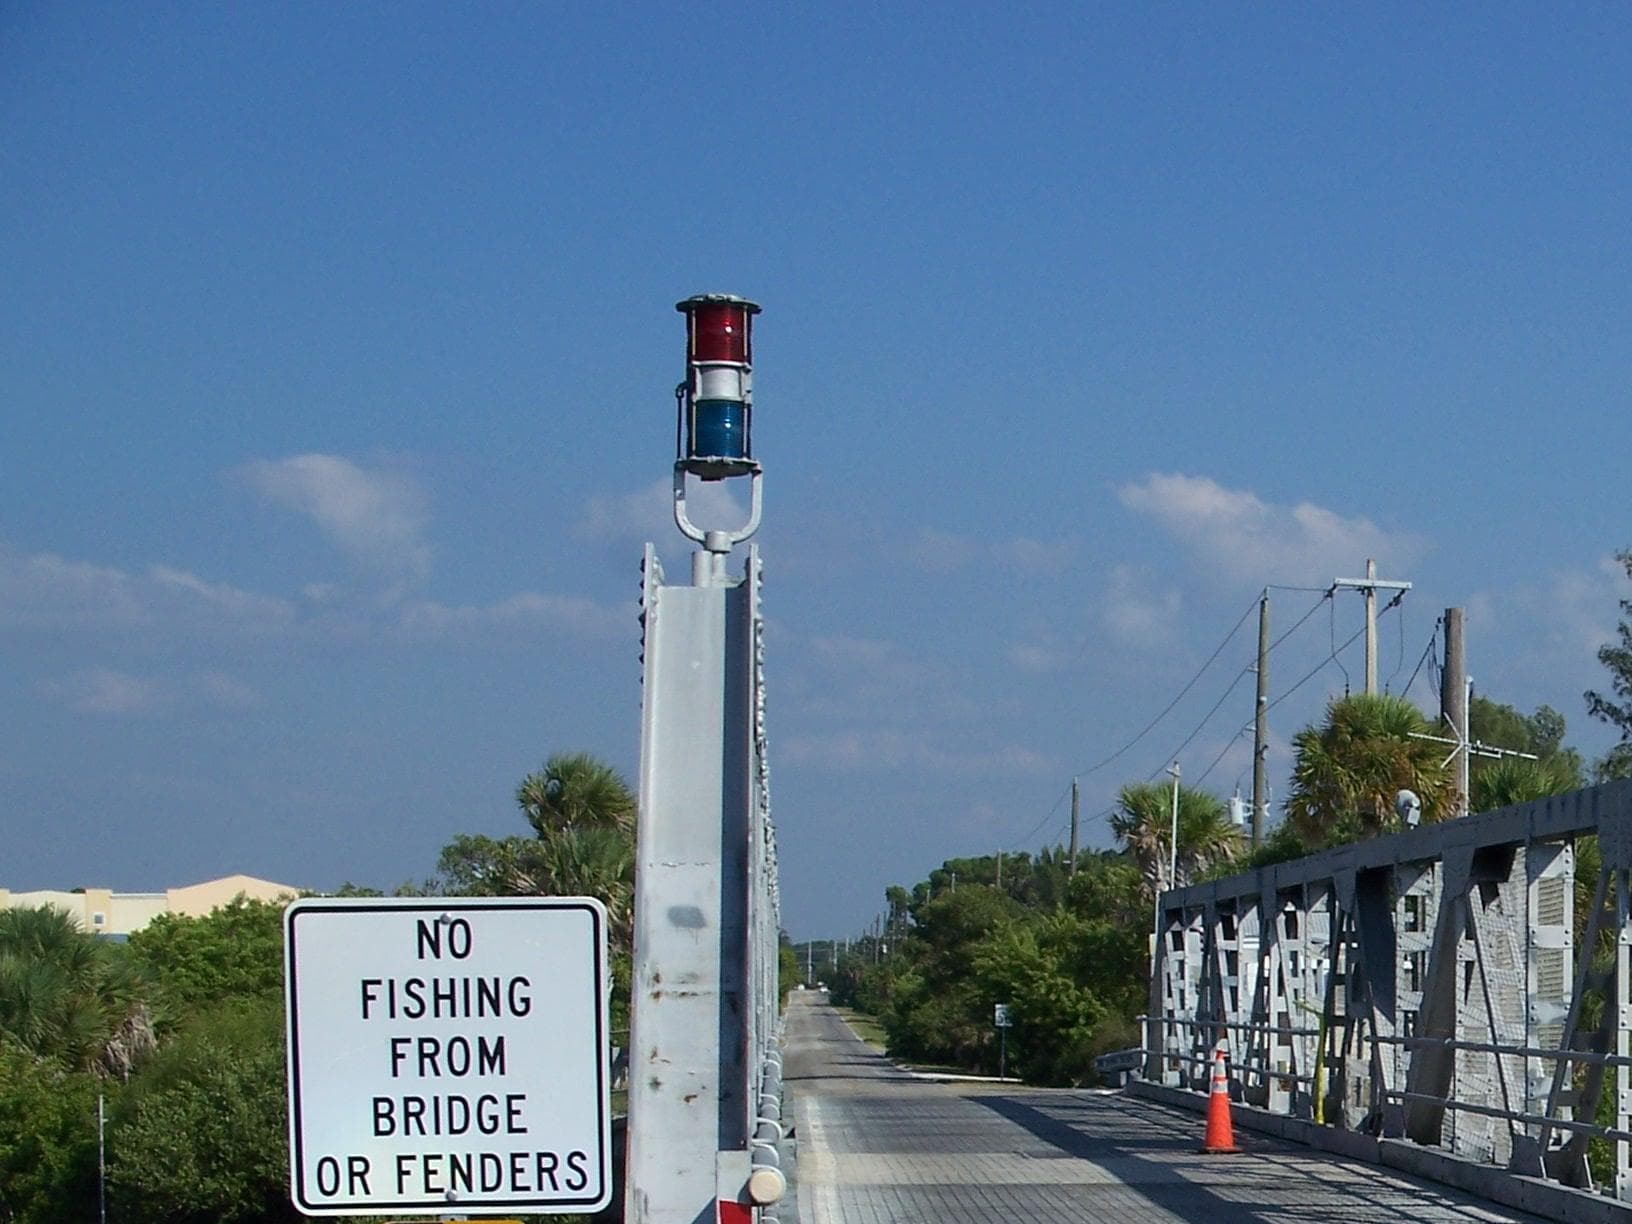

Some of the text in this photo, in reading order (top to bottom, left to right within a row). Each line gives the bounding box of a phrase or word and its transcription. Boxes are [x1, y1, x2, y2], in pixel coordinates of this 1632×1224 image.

[417, 918, 471, 959] NO
[361, 976, 531, 1019] FISHING
[391, 1036, 506, 1077] FROM
[373, 1094, 527, 1136] BRIDGE
[317, 1151, 588, 1196] OR FENDERS
